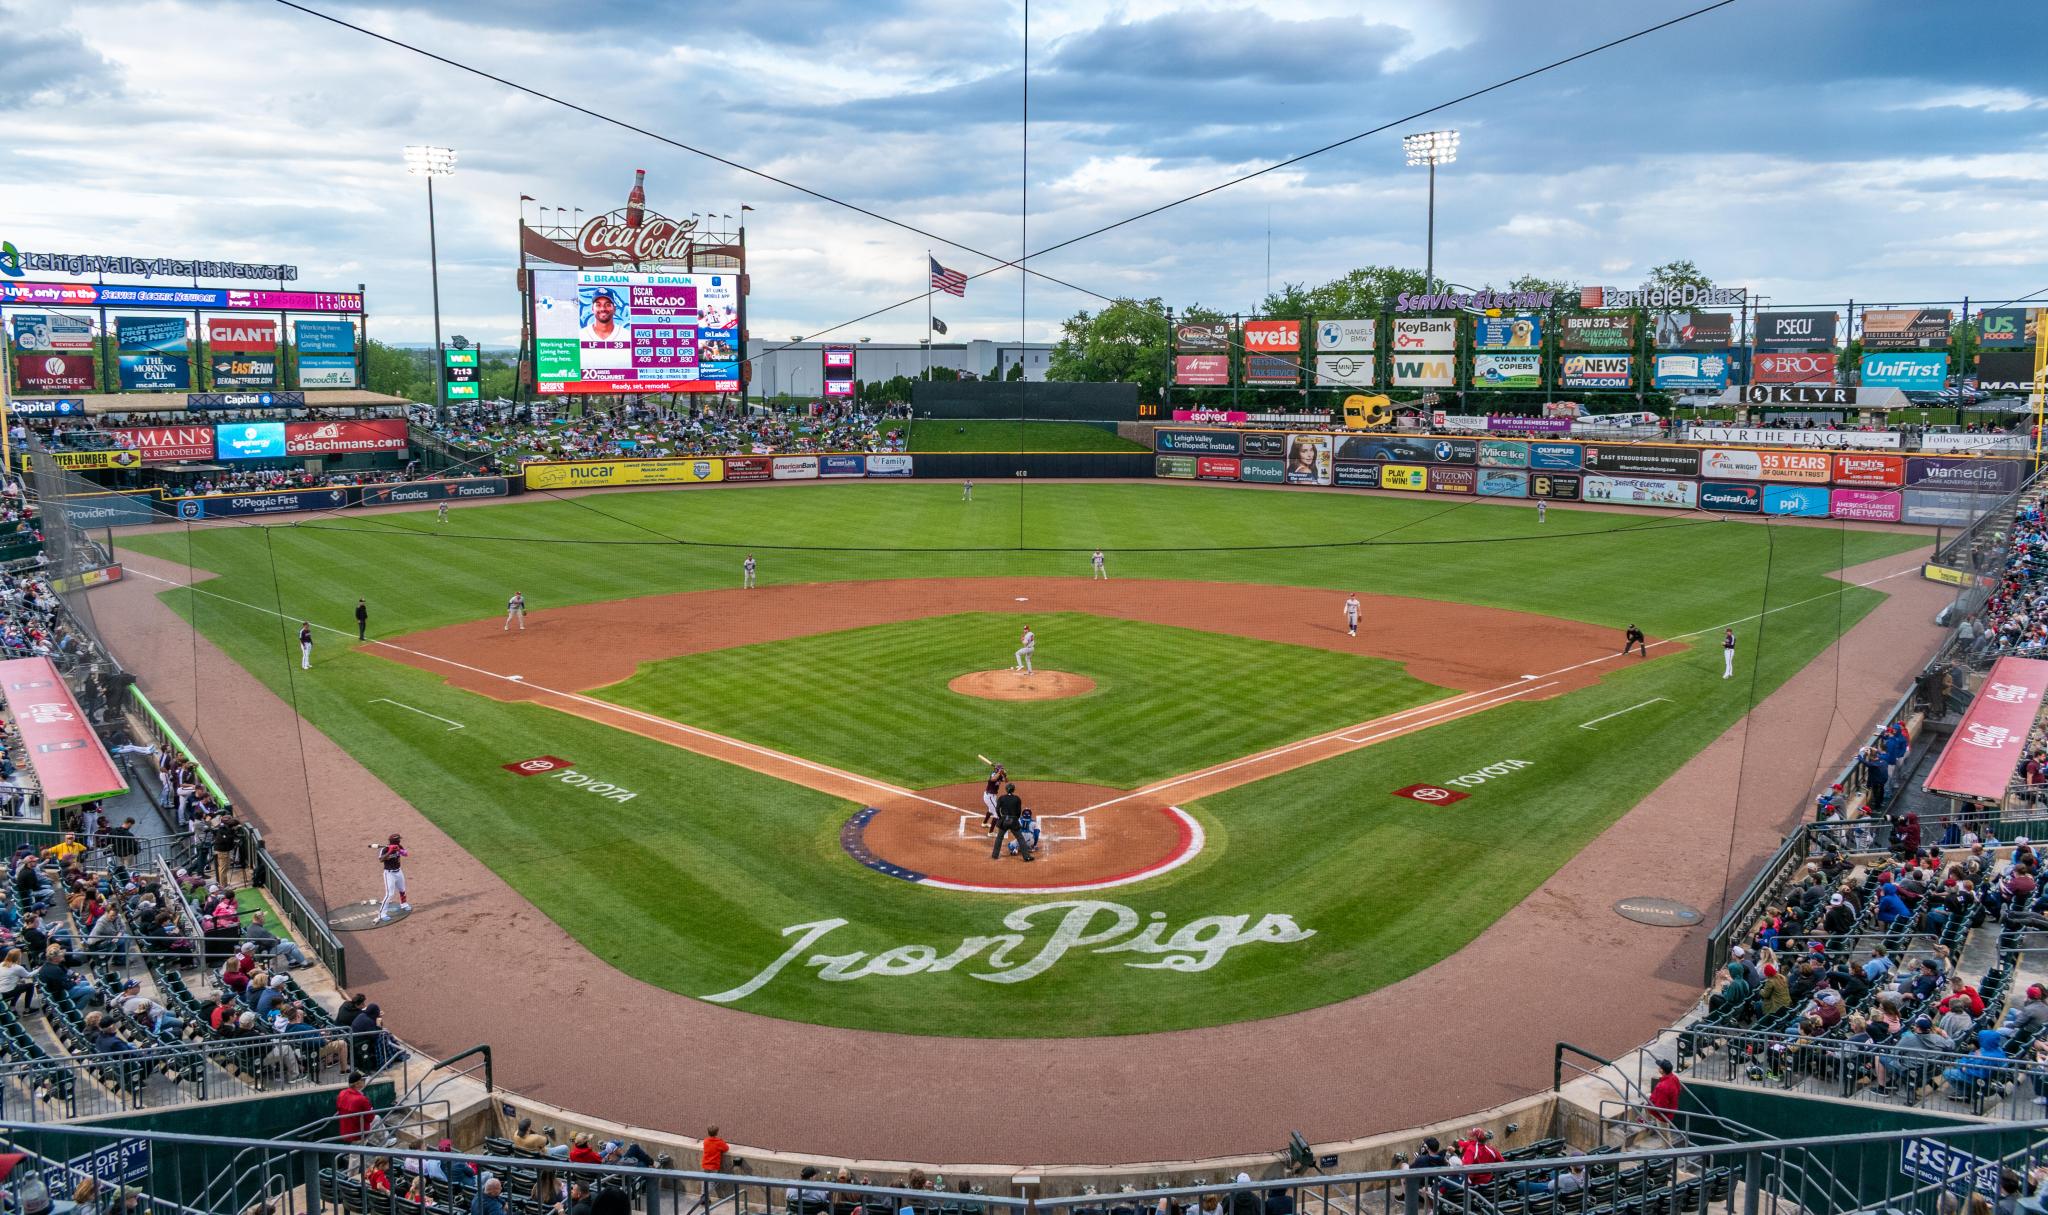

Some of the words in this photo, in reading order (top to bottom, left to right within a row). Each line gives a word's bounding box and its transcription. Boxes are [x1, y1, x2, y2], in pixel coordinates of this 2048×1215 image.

[578, 216, 698, 259] Coca-Cola
[25, 252, 95, 276] Lehigh
[95, 255, 155, 279] Valley
[157, 258, 217, 277] Health
[220, 262, 294, 280] Network
[613, 262, 664, 273] PARK
[5, 287, 33, 298] LIVE,
[34, 289, 60, 300] only
[61, 290, 76, 298] on
[77, 290, 97, 299] the
[1603, 284, 1731, 308] PenTeleData
[634, 297, 685, 306] MERCADO
[1395, 292, 1467, 312] SERVICE
[1473, 290, 1554, 309] ELECTRIC
[1398, 321, 1452, 334] KeyBank
[1568, 318, 1592, 328] IBEW
[1593, 318, 1610, 328] 375
[1776, 319, 1811, 335] PSECU
[121, 329, 146, 337] FIRST
[148, 325, 184, 334] SOURCE
[1215, 325, 1224, 333] 50
[1580, 328, 1623, 338] POWERING
[121, 336, 147, 344] FOR
[149, 331, 184, 340] NEWS
[211, 328, 273, 342] GIANT
[301, 333, 319, 341] Living
[1246, 326, 1298, 345] weis
[1984, 332, 2014, 340] FOODS
[301, 341, 322, 349] Giving
[145, 357, 164, 365] THE
[1564, 356, 1584, 374] 69
[1585, 359, 1627, 372] NEWS
[1776, 356, 1827, 373] BROC
[133, 365, 176, 373] MORNING
[1396, 362, 1449, 379] WM
[1866, 361, 1941, 376] UniFirst
[1566, 378, 1625, 387] WFMZ.COM
[225, 395, 259, 405] Capital
[1780, 388, 1847, 402] KLYR
[12, 402, 55, 413] Capital
[1450, 416, 1477, 425] MEMBERS
[1174, 434, 1195, 442] Lehigh
[1195, 434, 1213, 443] Valley
[1693, 429, 1748, 440] KLYR
[1756, 432, 1785, 441] THE
[1793, 432, 1847, 444] FENCE
[1928, 435, 1960, 444] Follow
[286, 438, 405, 452] GoBachmans.com
[1174, 442, 1208, 450] Orthopedic
[153, 448, 211, 457] REMODELING
[1482, 447, 1507, 457] Mike
[1509, 451, 1525, 460] Ike
[1538, 447, 1575, 455] OLYMPUS
[74, 454, 108, 464] LUMBER
[881, 458, 906, 466] Family
[1617, 455, 1659, 463] STROUDSBURG
[1763, 455, 1778, 467] 35
[1782, 456, 1826, 469] YEARS
[1839, 458, 1884, 469] Hursh's
[571, 465, 615, 478] nucar
[1252, 466, 1282, 476] Phoebe
[1432, 470, 1472, 481] KUTZTOWN
[1926, 466, 1997, 479] viamedia
[1483, 480, 1504, 488] Dorney
[1640, 481, 1666, 489] ELECTRIC
[392, 490, 428, 500] Fanatics
[459, 486, 495, 496] Fanatics
[244, 498, 277, 508] People
[278, 495, 298, 505] First
[1780, 498, 1799, 510] ppl
[67, 507, 116, 520] Provident
[1850, 509, 1894, 518] NETWORK
[1444, 759, 1535, 787] TOYOTA
[551, 770, 638, 803] TOYOTA
[1620, 904, 1674, 917] Capital
[1905, 1140, 1961, 1177] BSI
